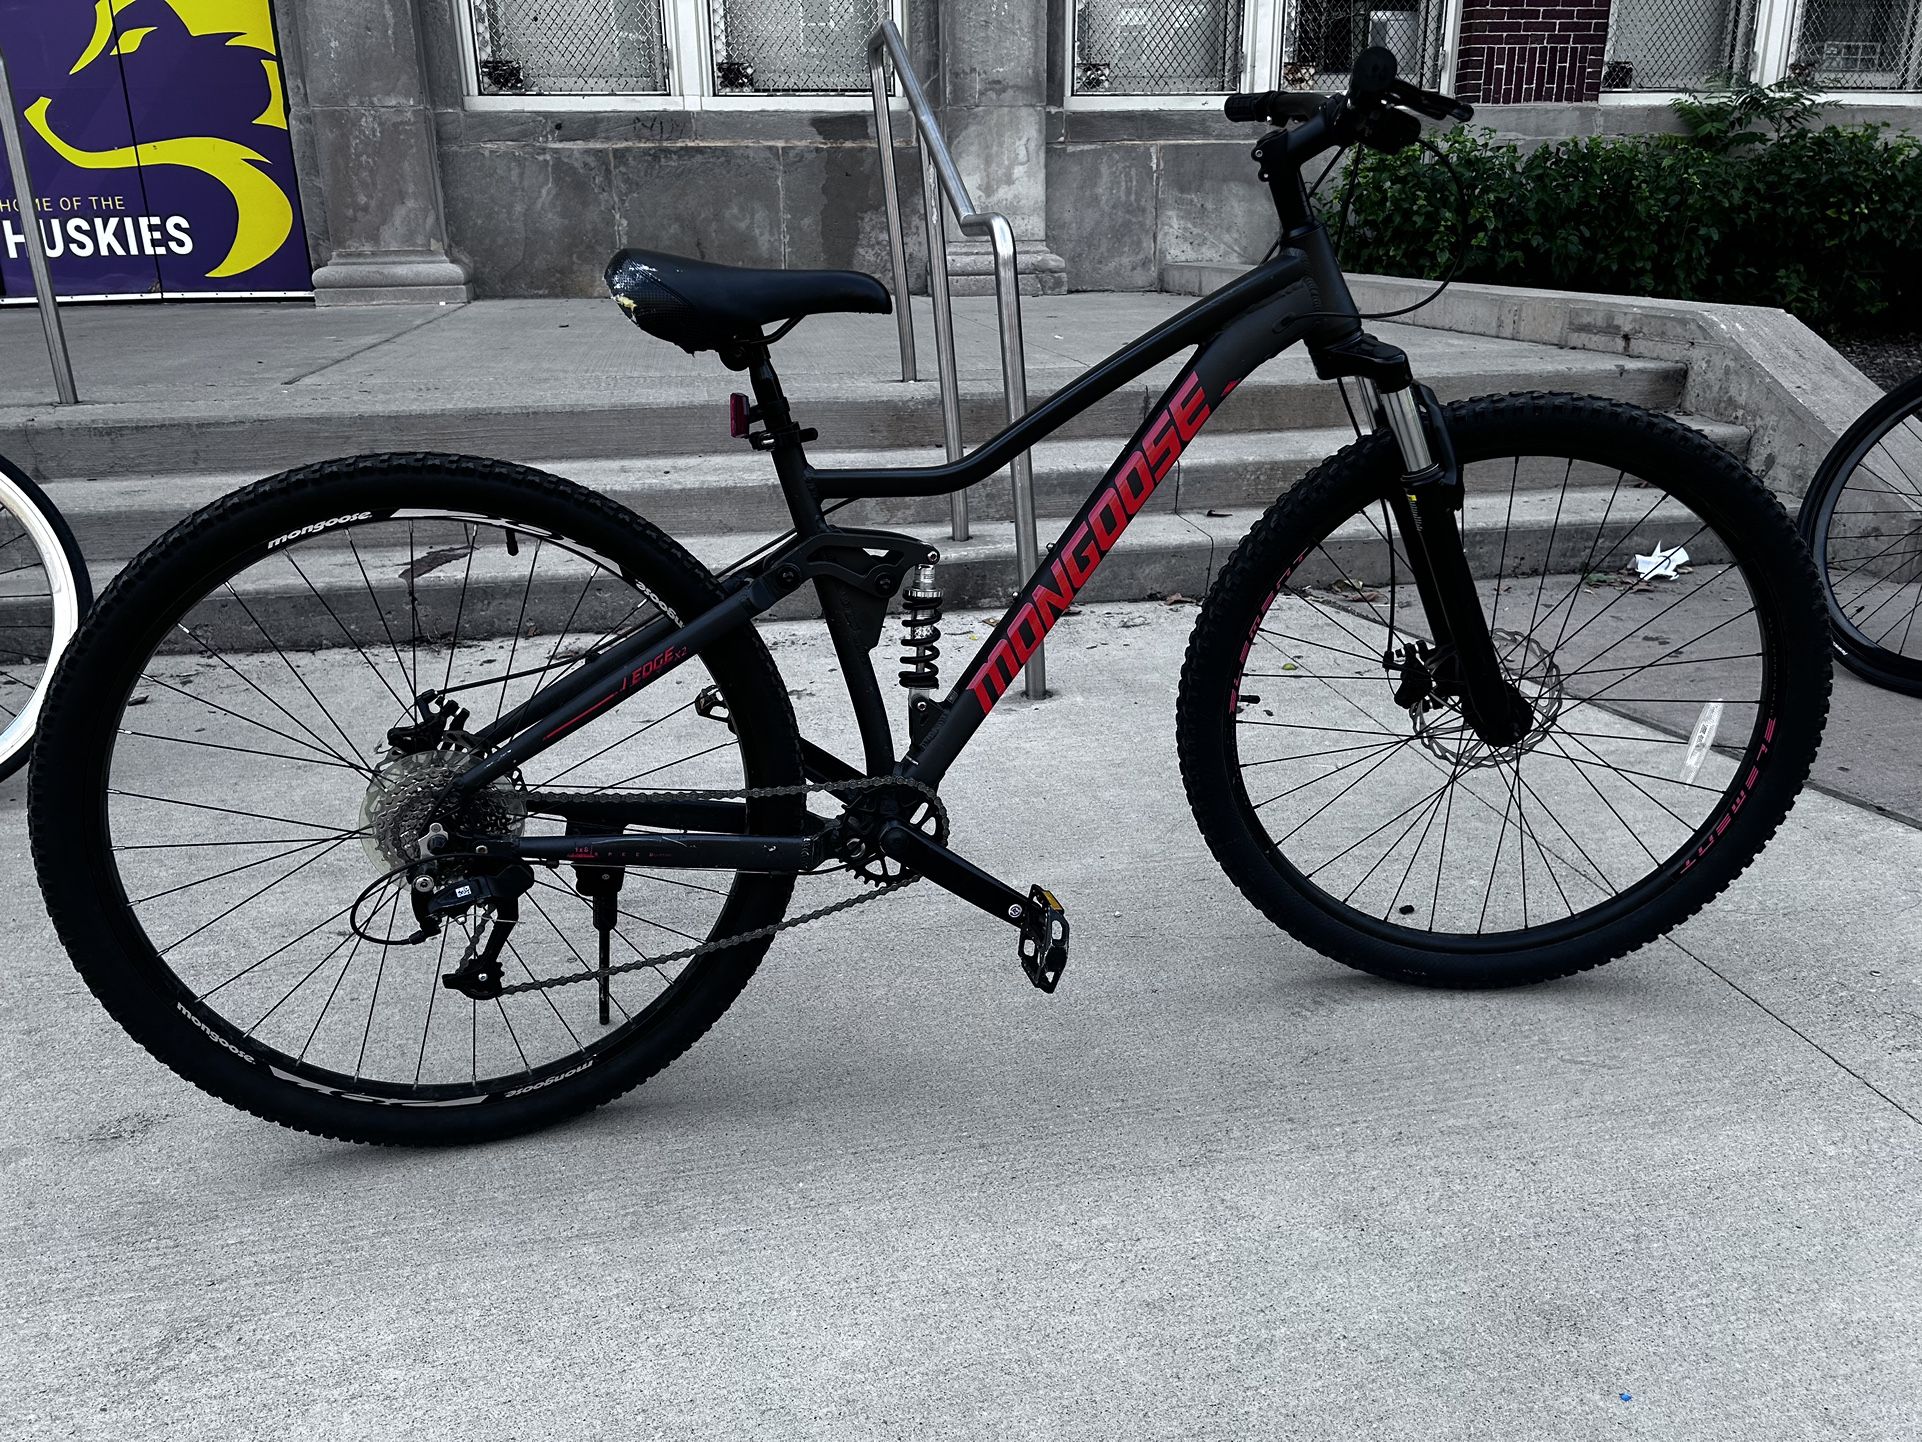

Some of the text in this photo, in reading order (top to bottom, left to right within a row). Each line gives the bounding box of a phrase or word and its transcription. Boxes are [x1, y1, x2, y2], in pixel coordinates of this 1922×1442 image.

[59, 196, 82, 211] OF
[88, 196, 126, 210] THE
[2, 215, 194, 259] HUSKIES
[267, 510, 372, 550] mongoose
[966, 371, 1210, 714] MONGOOSE
[635, 579, 685, 629] ngoose
[176, 1001, 256, 1065] mongoose
[505, 1060, 594, 1098] mongoose
